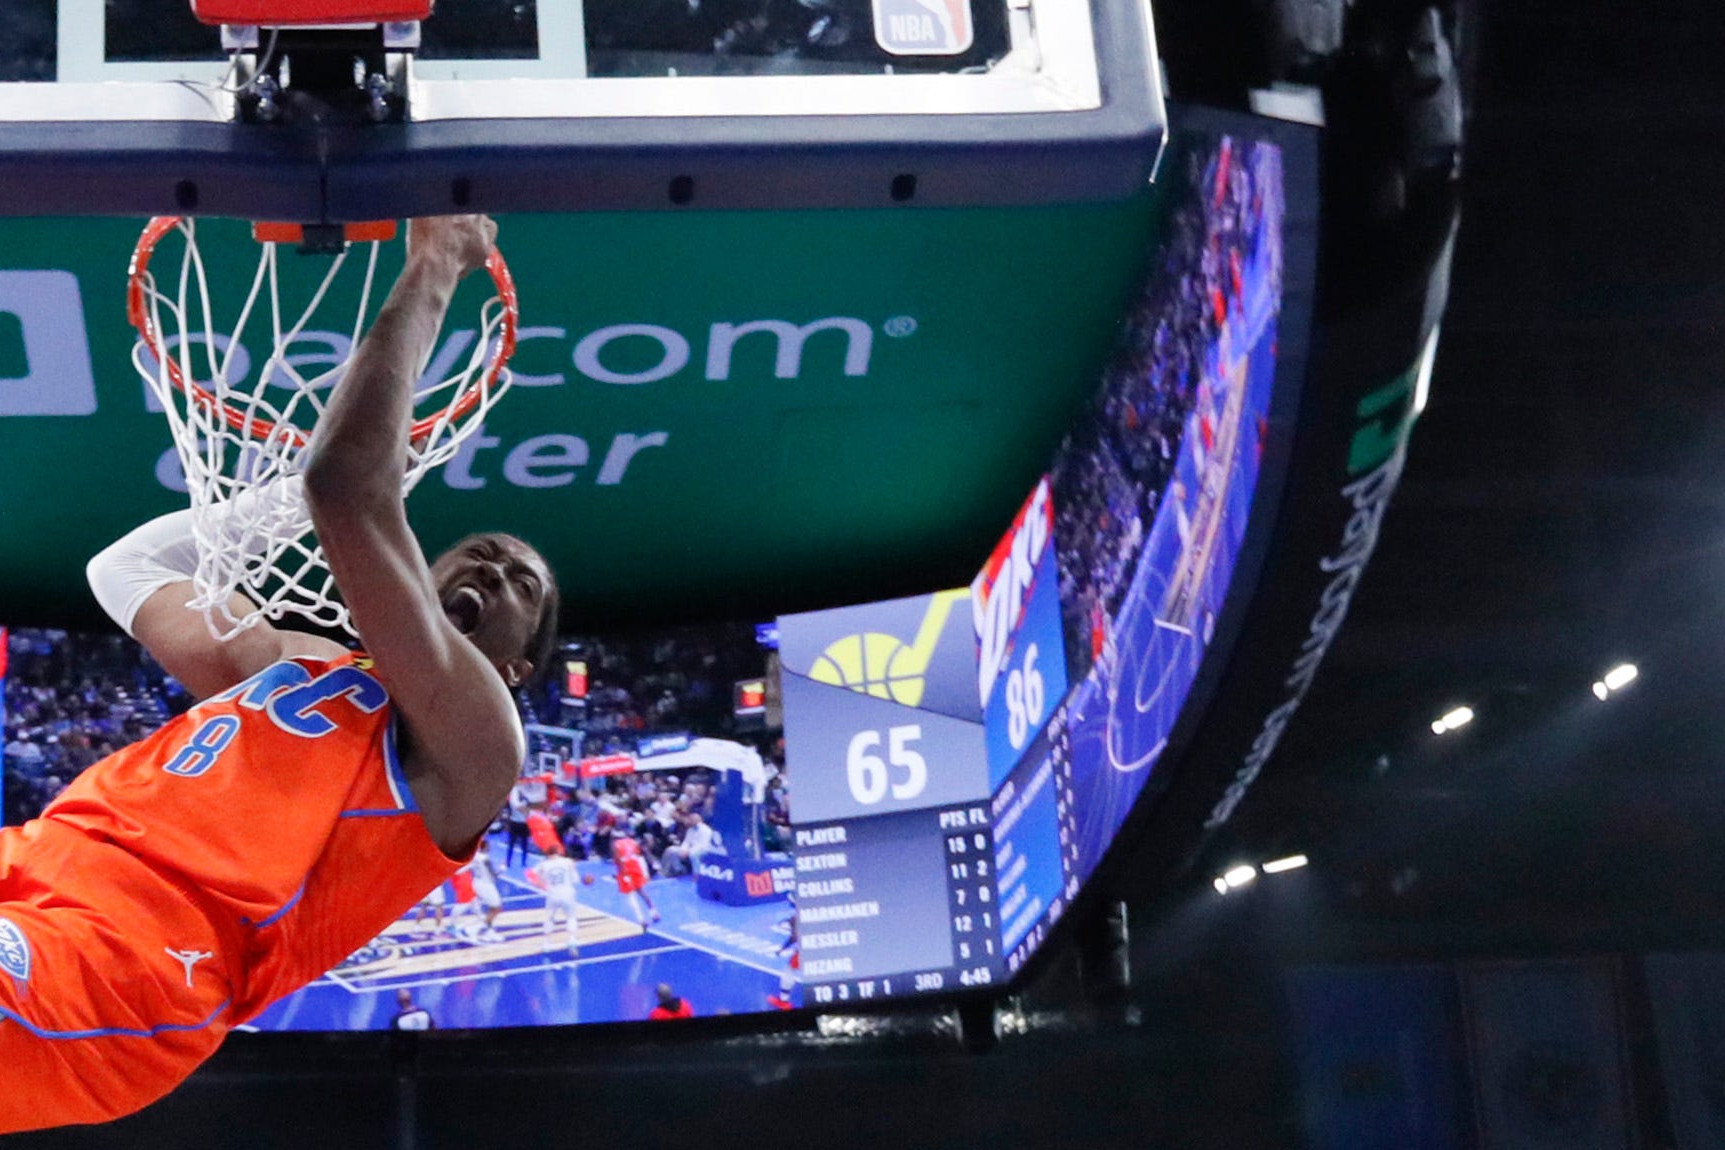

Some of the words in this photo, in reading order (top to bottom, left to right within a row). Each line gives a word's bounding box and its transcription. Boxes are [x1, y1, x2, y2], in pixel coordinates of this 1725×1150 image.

[890, 14, 937, 42] NBA
[1006, 642, 1045, 750] 86
[162, 714, 241, 777] 8
[847, 725, 928, 805] 65
[796, 826, 848, 847] PLAYER
[939, 811, 967, 829] PTS
[969, 808, 988, 825] FL
[796, 853, 848, 872] SEXTON
[948, 836, 968, 853] 15
[974, 833, 986, 850] 0
[798, 878, 855, 898] COLLINS
[951, 863, 968, 879] 11
[977, 860, 988, 877] 2
[800, 901, 880, 924] MARKKANEN
[955, 889, 966, 905] 7
[801, 930, 859, 950] KESSLER
[955, 915, 973, 932] 12
[983, 912, 992, 929] 1
[985, 939, 994, 955] 1
[915, 973, 944, 992] 3RD
